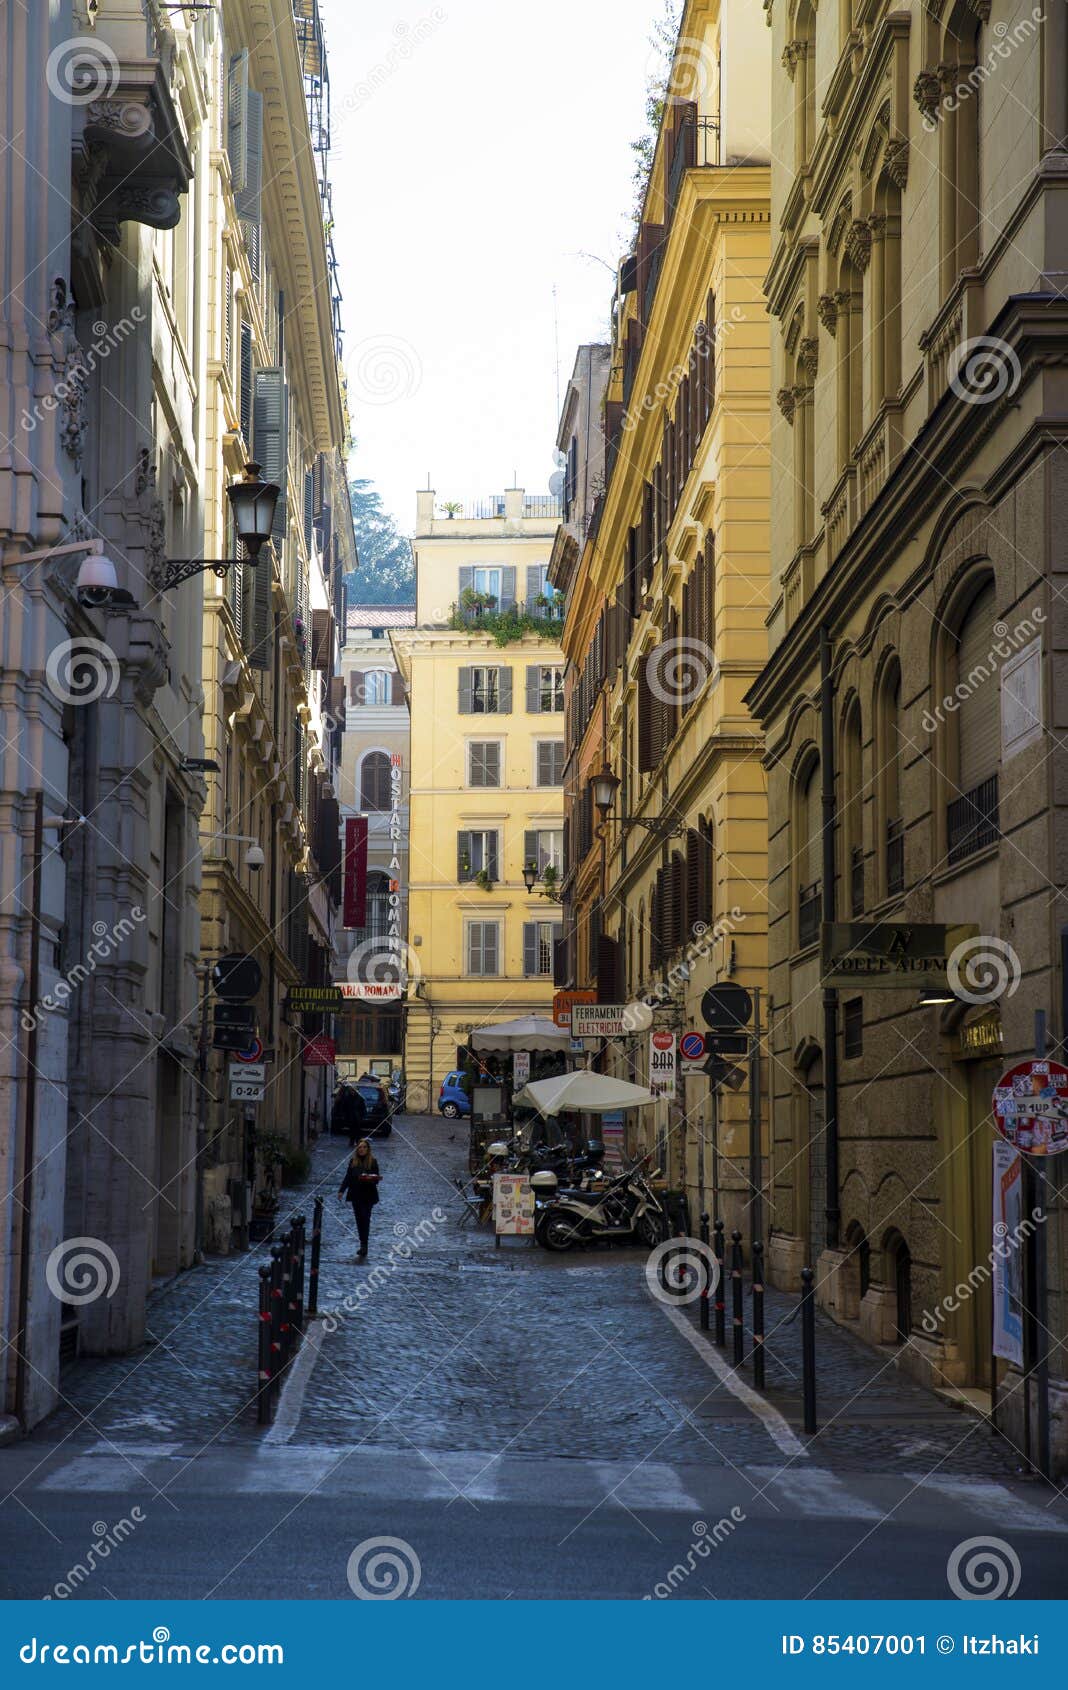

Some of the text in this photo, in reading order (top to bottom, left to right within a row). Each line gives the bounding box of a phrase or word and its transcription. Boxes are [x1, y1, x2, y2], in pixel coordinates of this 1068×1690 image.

[388, 753, 401, 870] HOSTARIA
[387, 879, 401, 967] ROMANA
[364, 985, 401, 996] ROMANA
[651, 1051, 674, 1070] BAR
